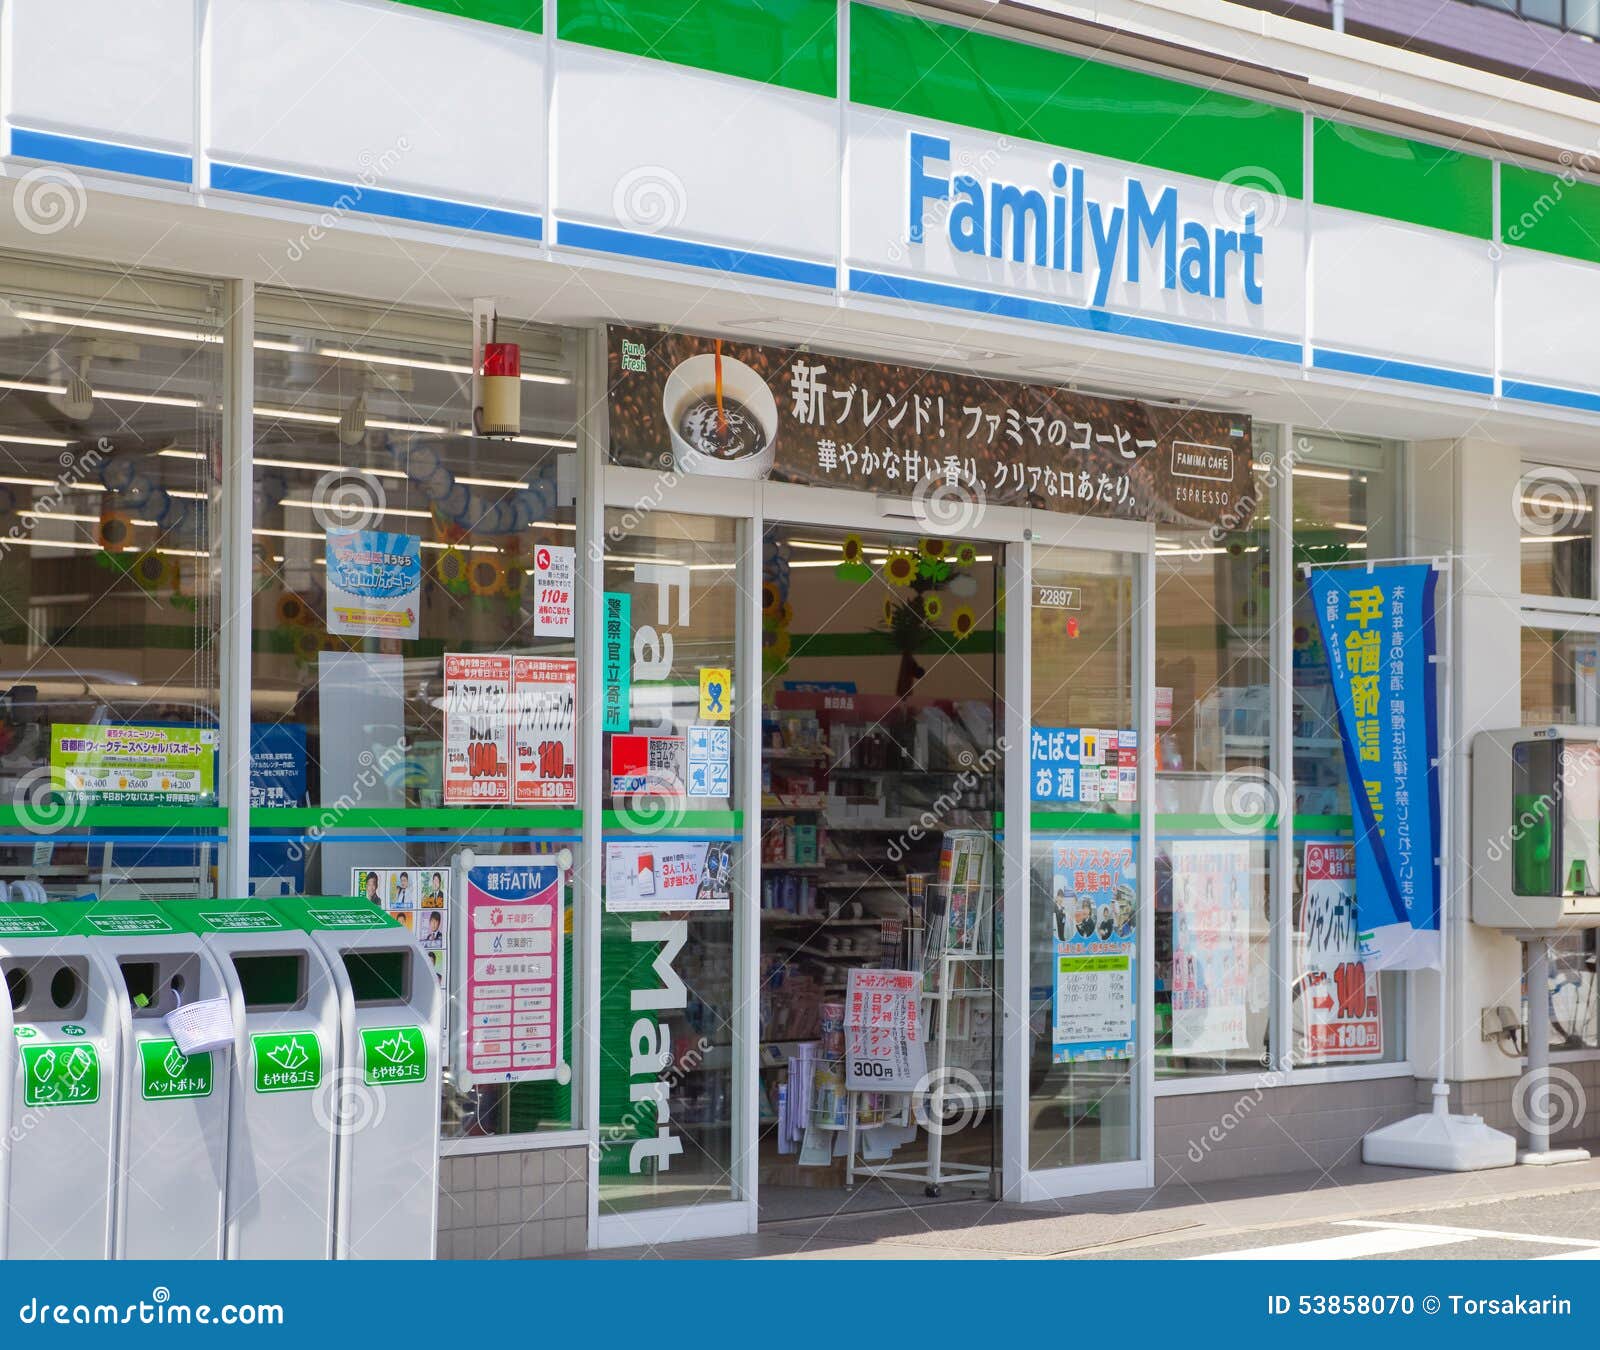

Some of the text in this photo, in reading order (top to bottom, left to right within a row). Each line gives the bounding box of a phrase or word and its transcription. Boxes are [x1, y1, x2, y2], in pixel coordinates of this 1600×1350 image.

[906, 129, 1264, 308] FamilyMart
[621, 354, 647, 372] Fresh
[1177, 452, 1229, 470] FAMIMA CAFÉ
[1176, 487, 1229, 506] ESPRESSO
[541, 588, 568, 603] 110番
[1039, 588, 1073, 606] 22897
[607, 598, 622, 726] 警察官立寄所
[1032, 731, 1080, 761] たばこ
[613, 776, 647, 791] SECOM
[1036, 767, 1075, 798] お酒
[1057, 848, 1133, 870] ストアスタッフ
[487, 872, 541, 891] 銀行ATM
[1073, 871, 1120, 893] 募集中!
[850, 992, 863, 1054] 東京スポーツ
[871, 993, 882, 1056] 日刊ゲンダイ
[881, 994, 893, 1056] 夕刊フジ
[263, 1071, 315, 1085] もやせるゴミ
[371, 1064, 420, 1079] もやせるゴミ
[853, 1062, 894, 1078] 300円
[34, 1083, 91, 1098] ビン カン
[148, 1078, 207, 1093] ペットボトル
